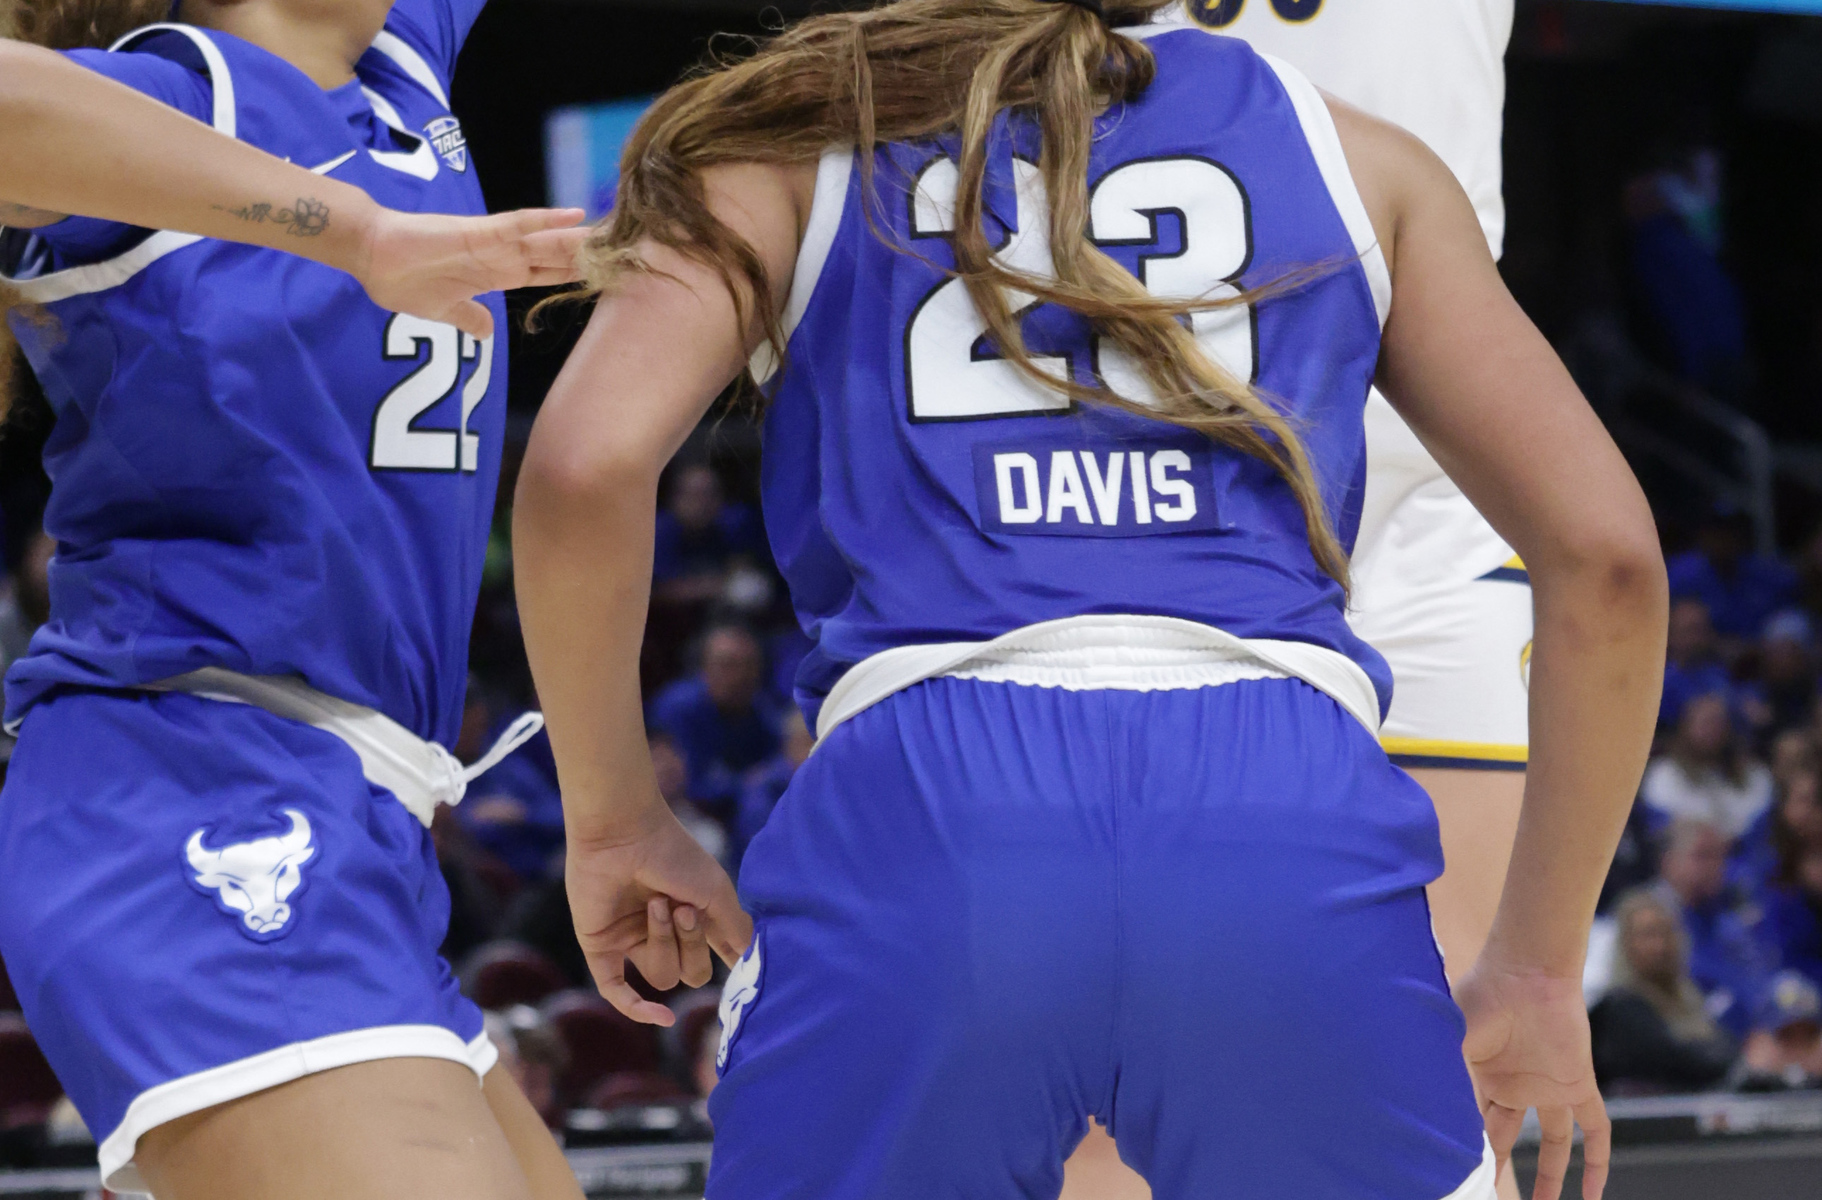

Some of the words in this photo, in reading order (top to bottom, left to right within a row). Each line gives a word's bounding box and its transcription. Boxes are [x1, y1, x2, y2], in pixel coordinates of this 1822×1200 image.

[904, 153, 1259, 424] 23
[370, 310, 494, 475] 22
[993, 448, 1198, 527] DAVIS
